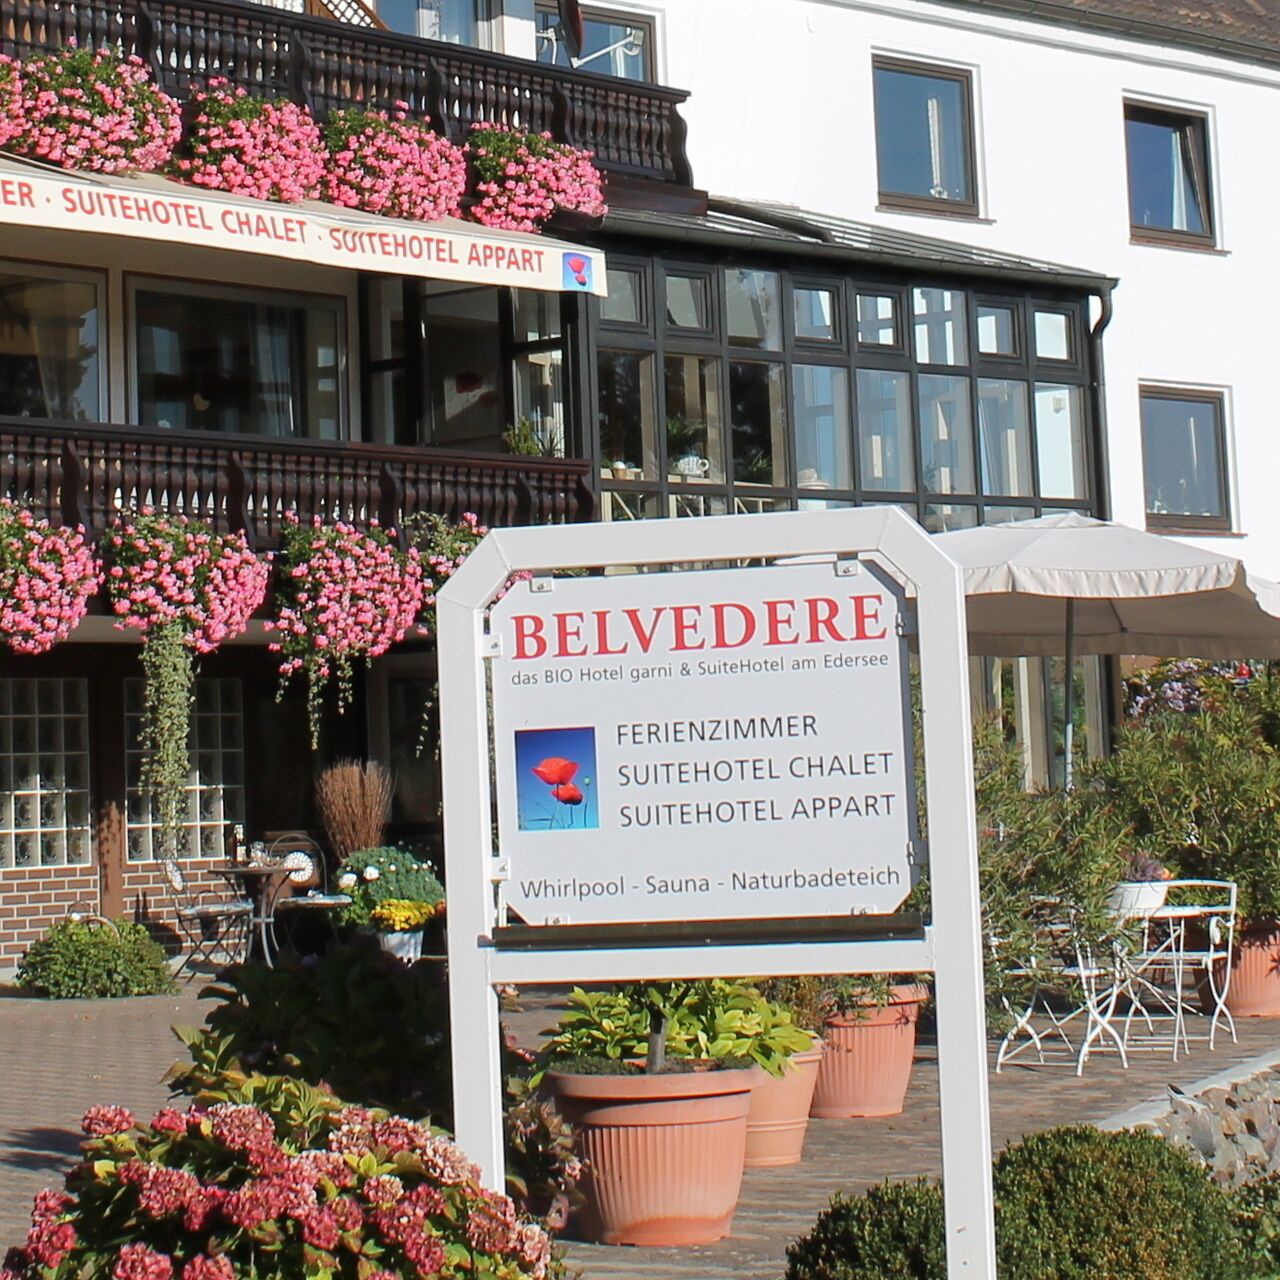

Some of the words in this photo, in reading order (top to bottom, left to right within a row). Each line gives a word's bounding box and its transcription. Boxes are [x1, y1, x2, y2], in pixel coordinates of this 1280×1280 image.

[61, 187, 214, 231] SUITEHOTEL
[221, 209, 308, 244] CHALET
[329, 227, 459, 264] SUITEHOTEL
[467, 244, 545, 273] APPART
[510, 594, 888, 660] BELVEDERE
[511, 670, 538, 685] das
[544, 668, 573, 684] BIO
[580, 665, 623, 682] Hotel
[630, 662, 672, 683] garni
[680, 662, 691, 677] &
[698, 656, 784, 676] SuiteHotel
[791, 658, 816, 671] am
[824, 652, 889, 669] Edersee
[617, 714, 819, 746] FERIENZIMMER
[618, 758, 781, 787] SUITEHOTEL
[789, 752, 894, 778] CHALET
[620, 799, 783, 827] SUITEHOTEL
[791, 794, 896, 821] APPART
[520, 876, 625, 902] Whirlpool
[646, 874, 710, 895] Sauna
[732, 865, 900, 891] Naturbadeteich
